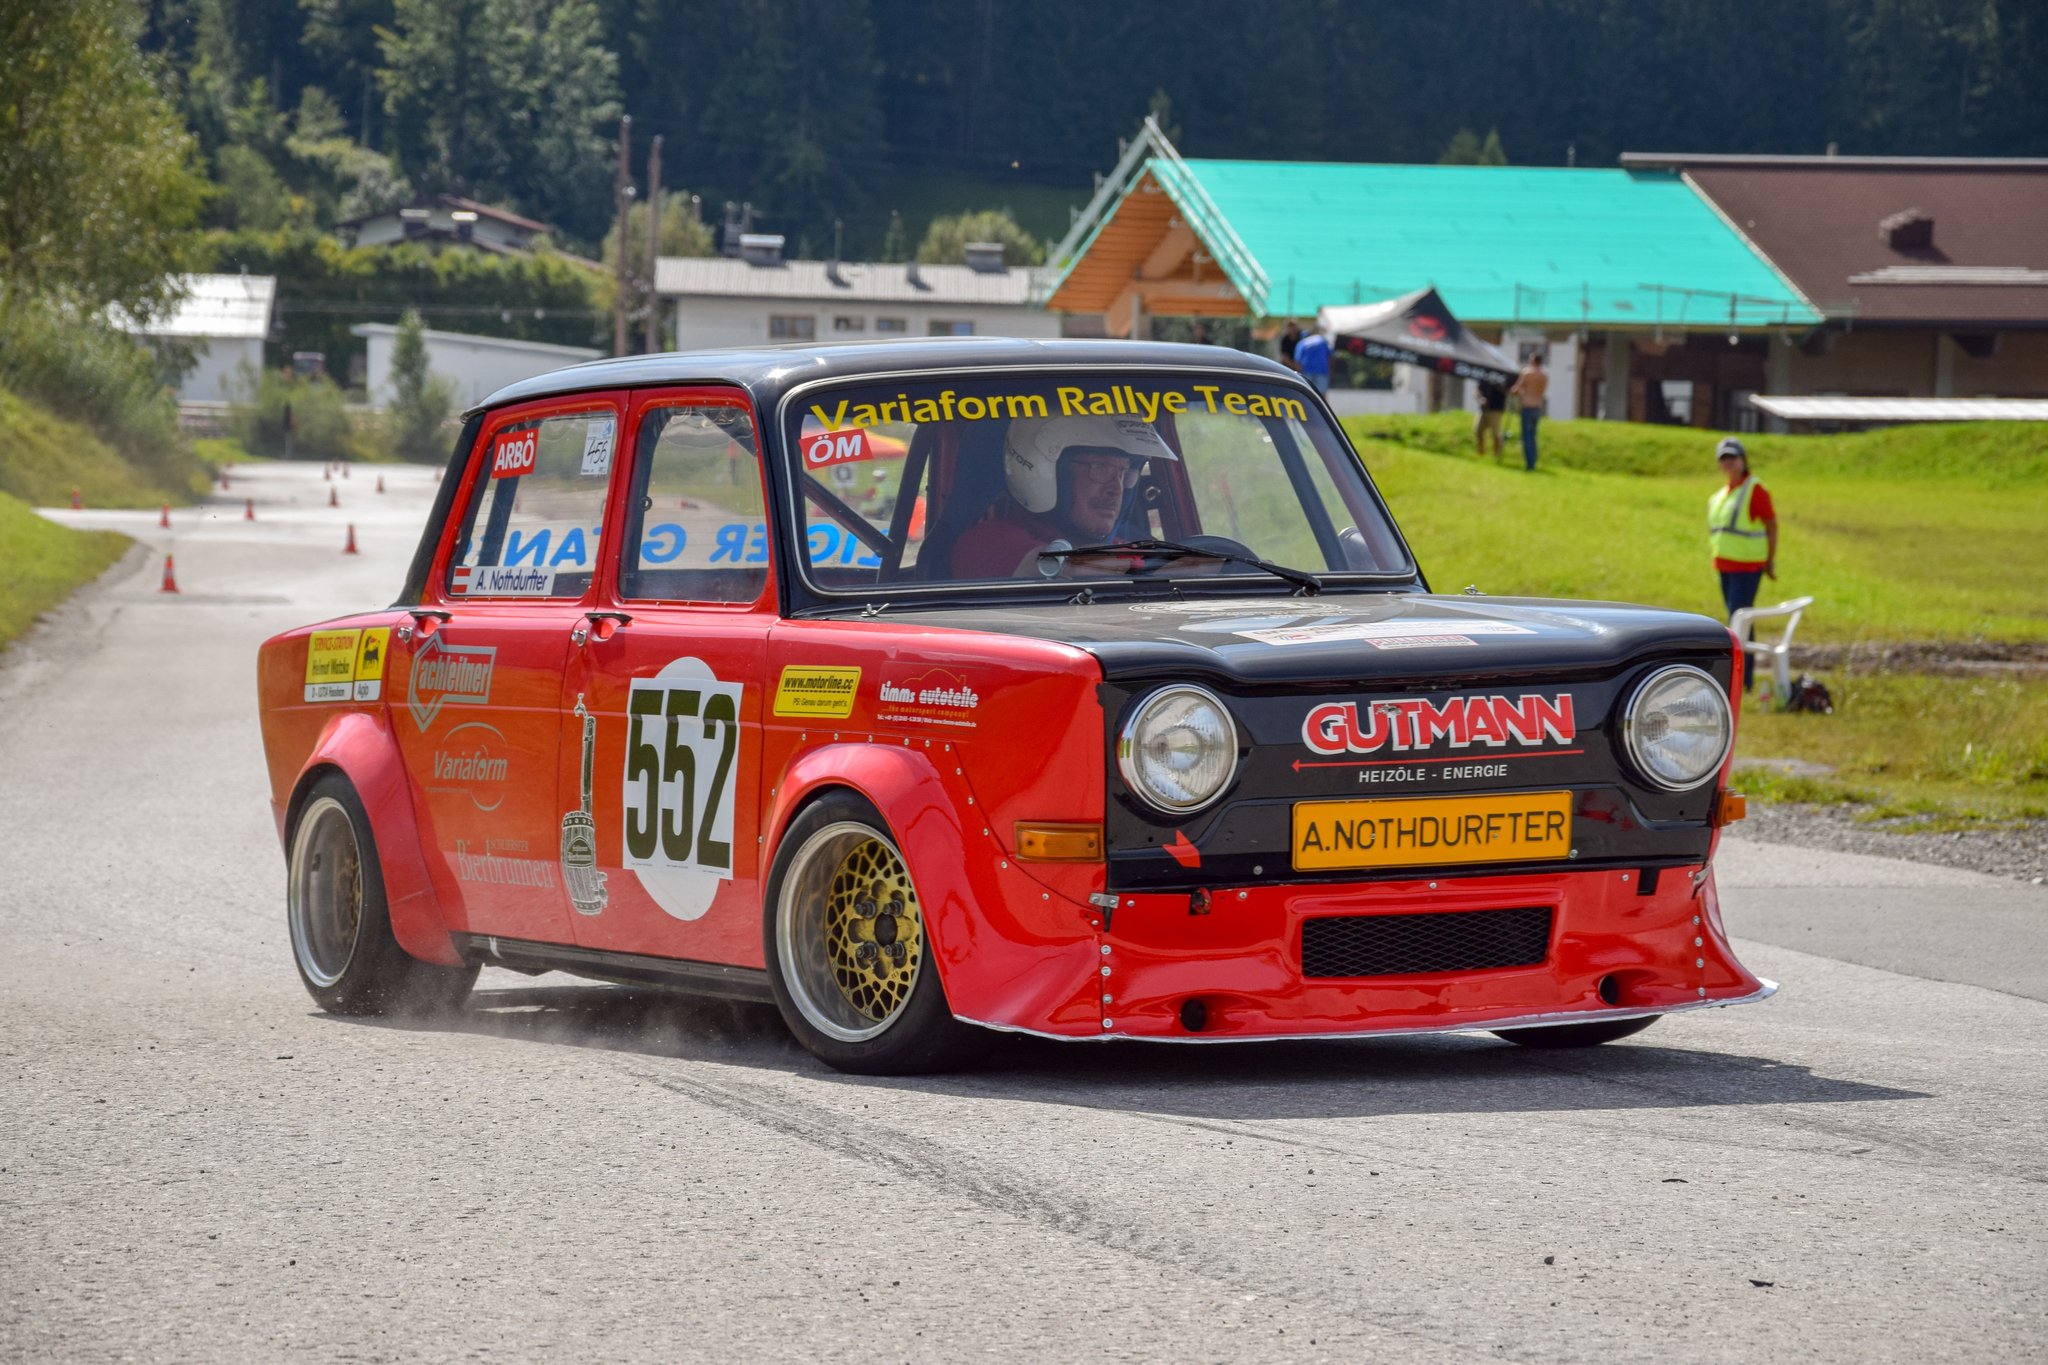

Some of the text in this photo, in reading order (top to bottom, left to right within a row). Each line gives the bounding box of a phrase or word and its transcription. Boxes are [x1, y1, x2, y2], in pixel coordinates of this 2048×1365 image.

[811, 385, 1308, 432] Variaform Rallye Team
[494, 432, 537, 471] ARBÖ
[808, 434, 862, 463] ÖM
[475, 570, 549, 591] A. Nothdurfter
[418, 655, 490, 693] achleitner
[784, 676, 854, 690] www.motorline.cc
[879, 680, 979, 708] timms autoteile
[1302, 694, 1577, 756] GUTMANN
[433, 751, 508, 781] Variaform
[626, 688, 738, 870] 552
[1359, 765, 1426, 783] HEIZÖLE
[1443, 763, 1509, 781] ENERGIE
[1301, 810, 1569, 853] A.NOTHDURFTER
